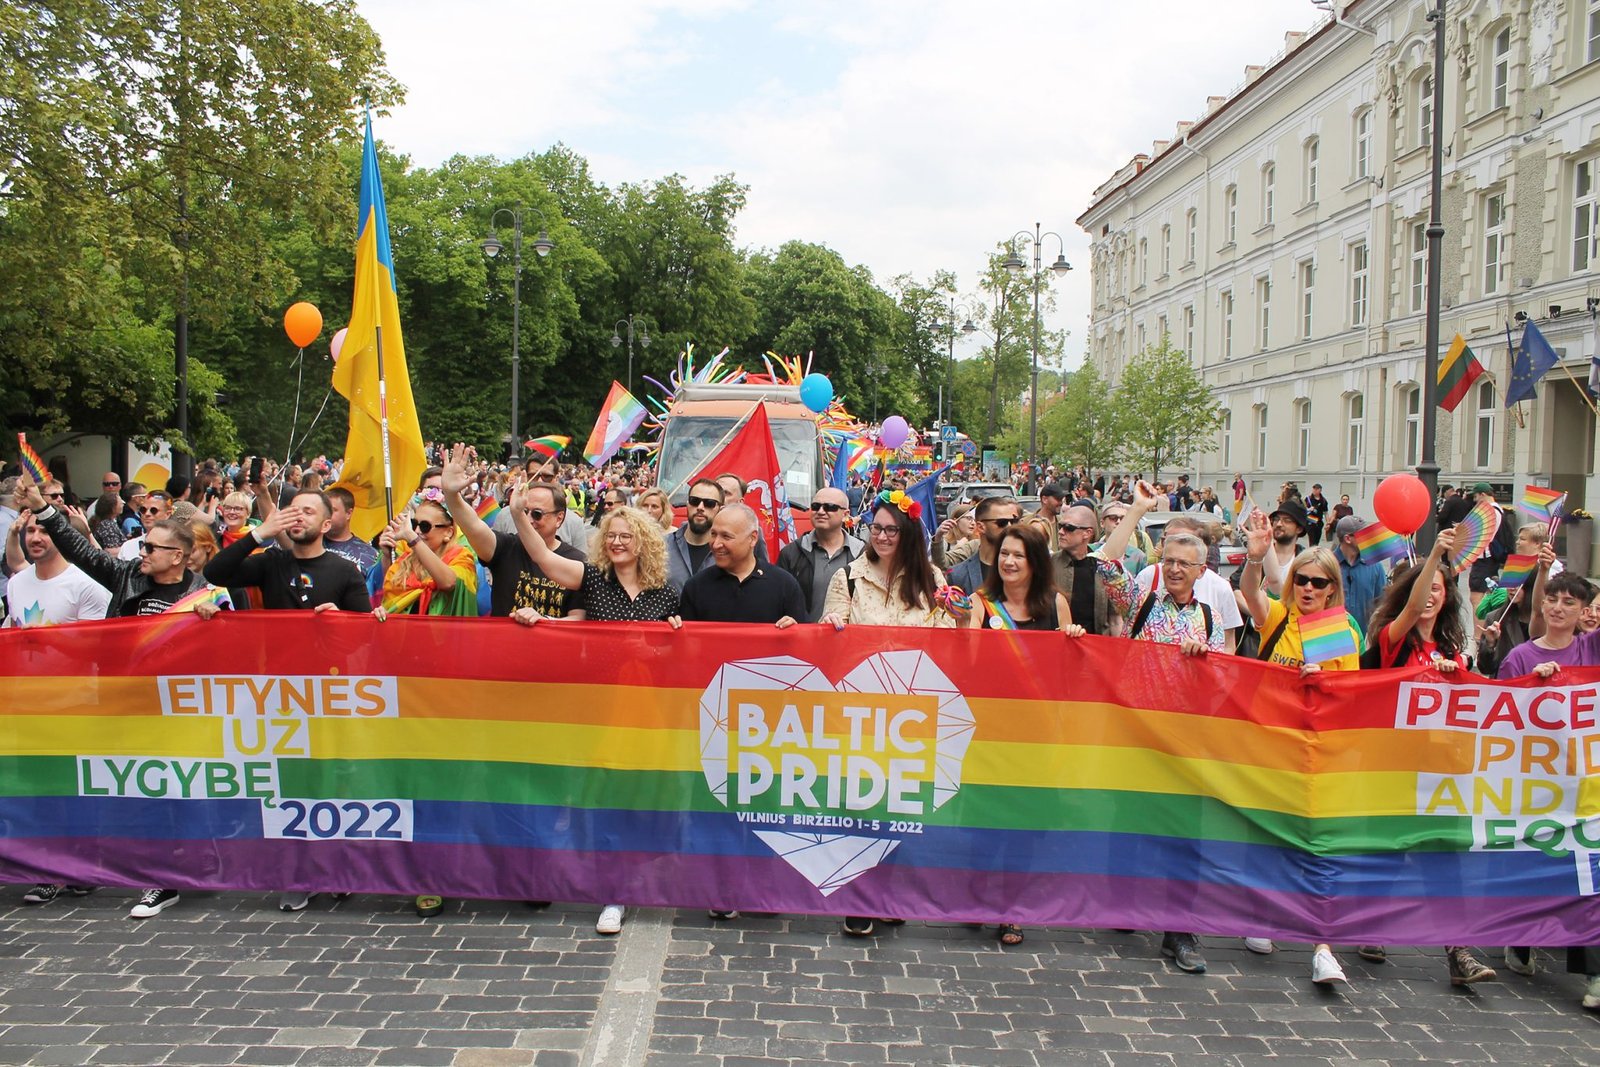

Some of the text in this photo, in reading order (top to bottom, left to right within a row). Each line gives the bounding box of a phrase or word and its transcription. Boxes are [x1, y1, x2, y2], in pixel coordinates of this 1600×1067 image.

[167, 667, 387, 717] EITYNĖS
[1406, 688, 1597, 730] PEACE
[232, 708, 304, 756] UŽ
[738, 703, 929, 753] BALTIC
[81, 759, 277, 808] LYGYBĘ
[737, 751, 926, 815] PRIDE
[1424, 776, 1564, 816] AND
[281, 801, 402, 838] 2022
[736, 811, 786, 825] VILNIUS
[793, 812, 854, 828] BIRŽELIO
[889, 820, 923, 834] 2022
[1482, 818, 1600, 857] EQU
